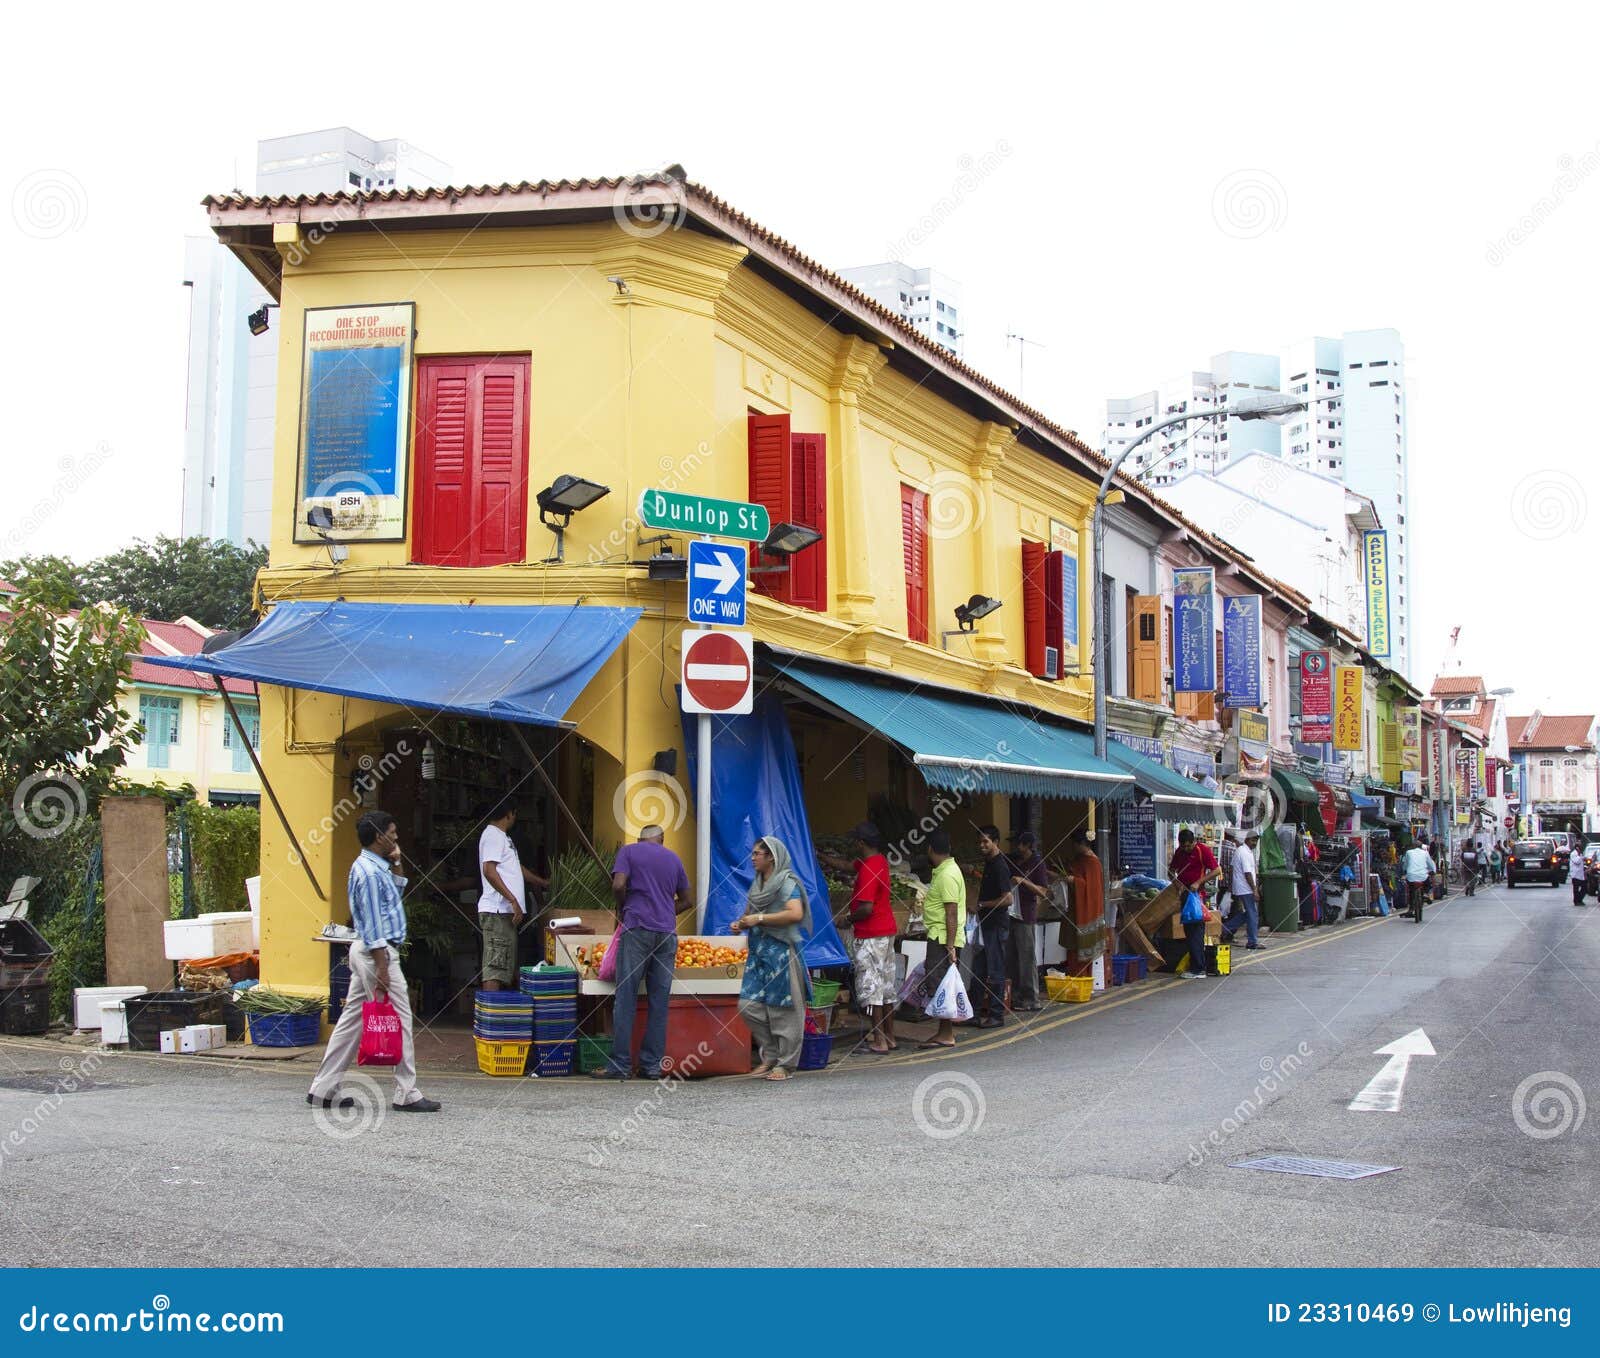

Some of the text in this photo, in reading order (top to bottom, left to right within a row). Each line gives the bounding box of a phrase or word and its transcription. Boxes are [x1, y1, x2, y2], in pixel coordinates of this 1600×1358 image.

[336, 315, 380, 329] ONE STOP
[309, 326, 407, 342] ACCOUNTING SERVICE
[340, 496, 361, 506] BSH
[655, 495, 758, 531] Dunlop St
[1370, 536, 1383, 586] APPOLLO
[693, 598, 741, 619] ONE WAY
[1180, 599, 1201, 610] AZ
[1226, 597, 1253, 617] AZ
[1342, 670, 1356, 712] RELAX
[1338, 712, 1346, 744] BEAUTY
[1350, 712, 1359, 744] SALON
